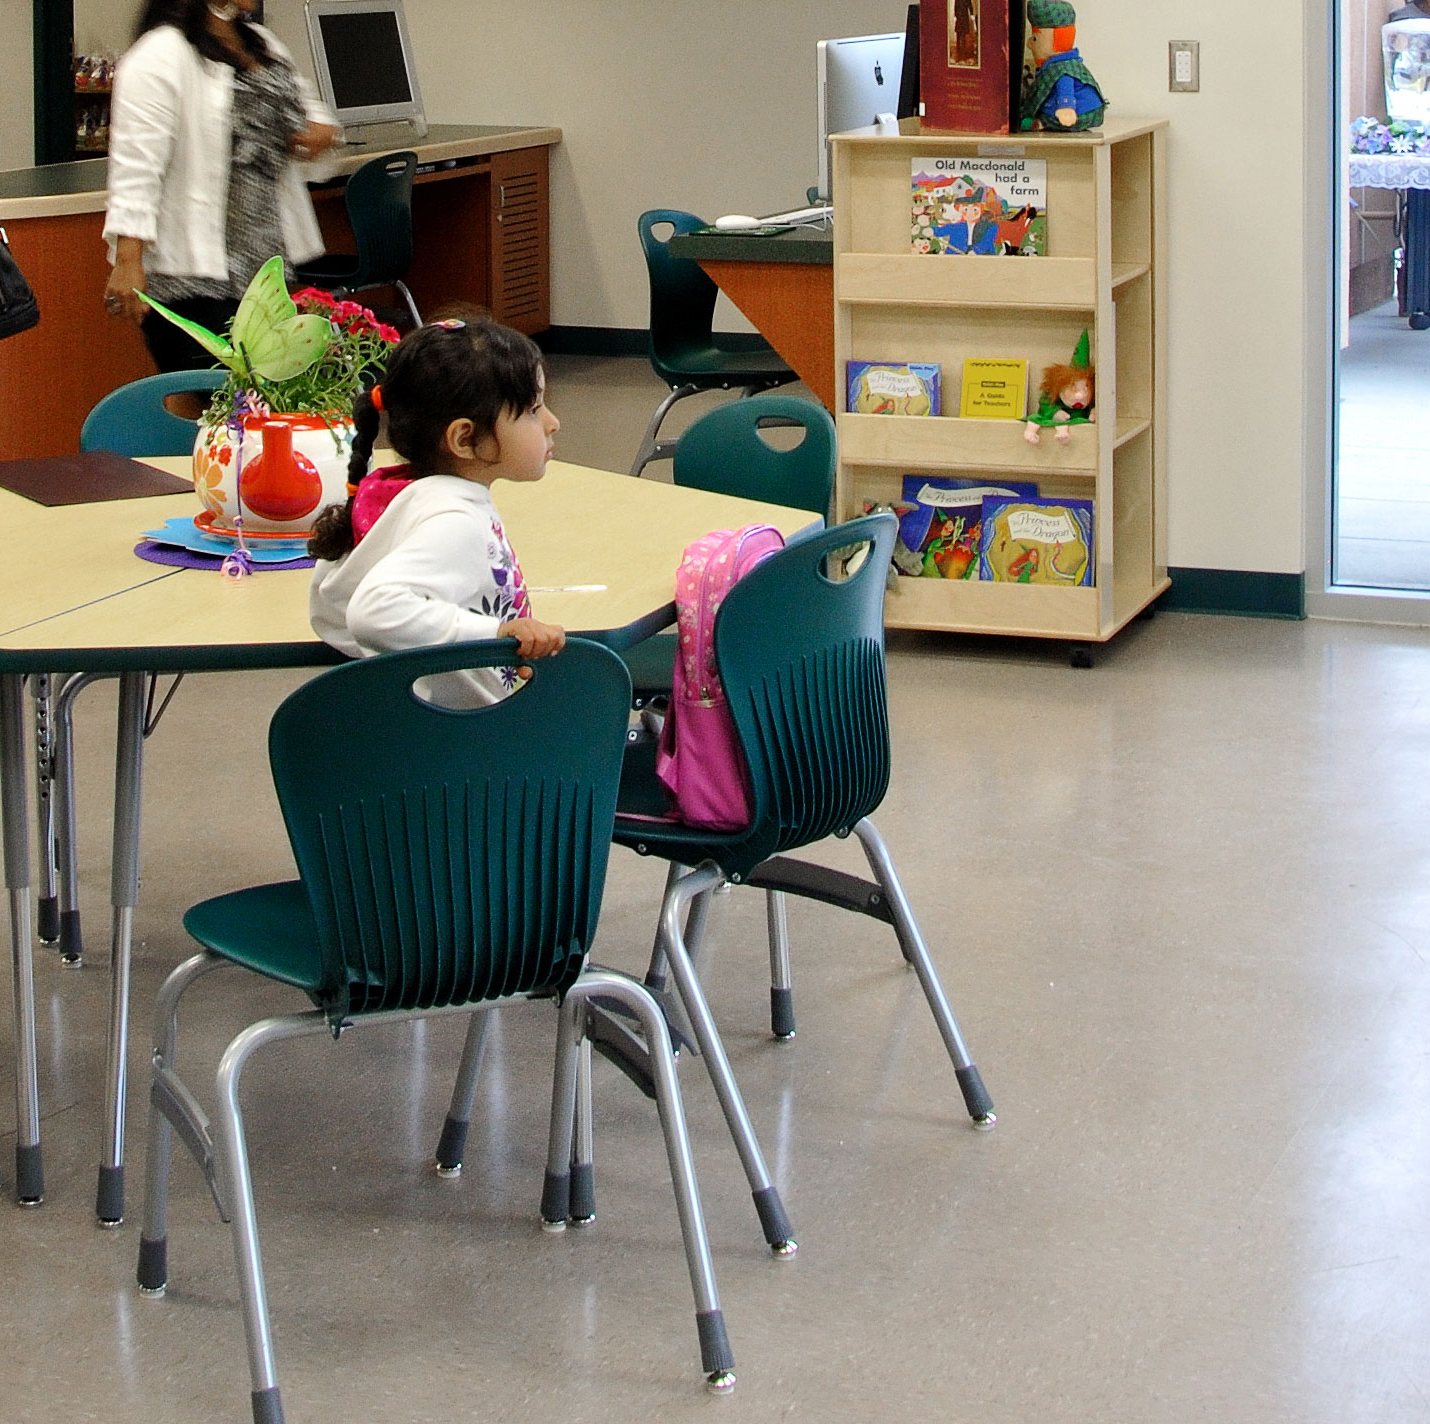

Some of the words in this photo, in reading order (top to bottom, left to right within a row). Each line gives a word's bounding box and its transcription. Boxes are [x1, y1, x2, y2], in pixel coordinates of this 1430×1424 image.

[935, 160, 956, 170] Old
[959, 160, 1025, 171] Macdonald
[995, 173, 1018, 183] had
[1010, 185, 1039, 195] farm
[1019, 512, 1060, 526] Princess
[1033, 526, 1069, 542] Dragon
